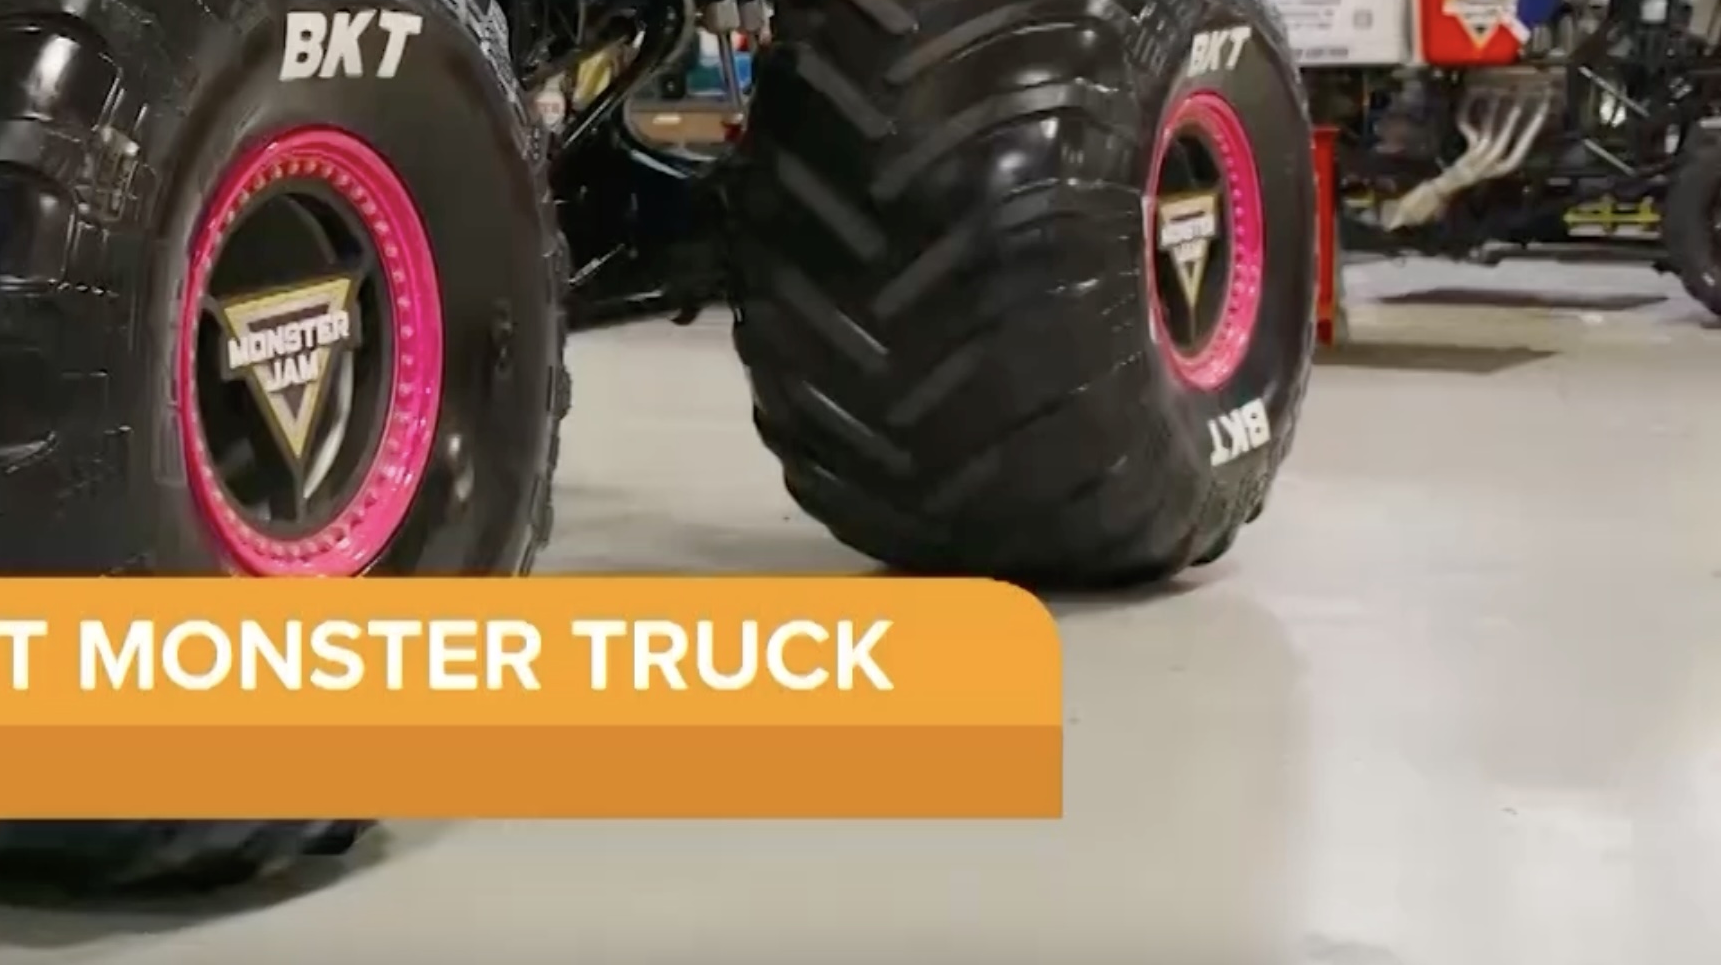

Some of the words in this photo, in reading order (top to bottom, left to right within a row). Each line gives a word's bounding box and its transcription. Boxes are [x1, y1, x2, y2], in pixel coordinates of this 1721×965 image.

[278, 8, 424, 83] BKT
[1186, 25, 1253, 77] BKT
[227, 309, 351, 370] MONSTER
[265, 348, 320, 393] JAM
[1206, 398, 1272, 467] BKT
